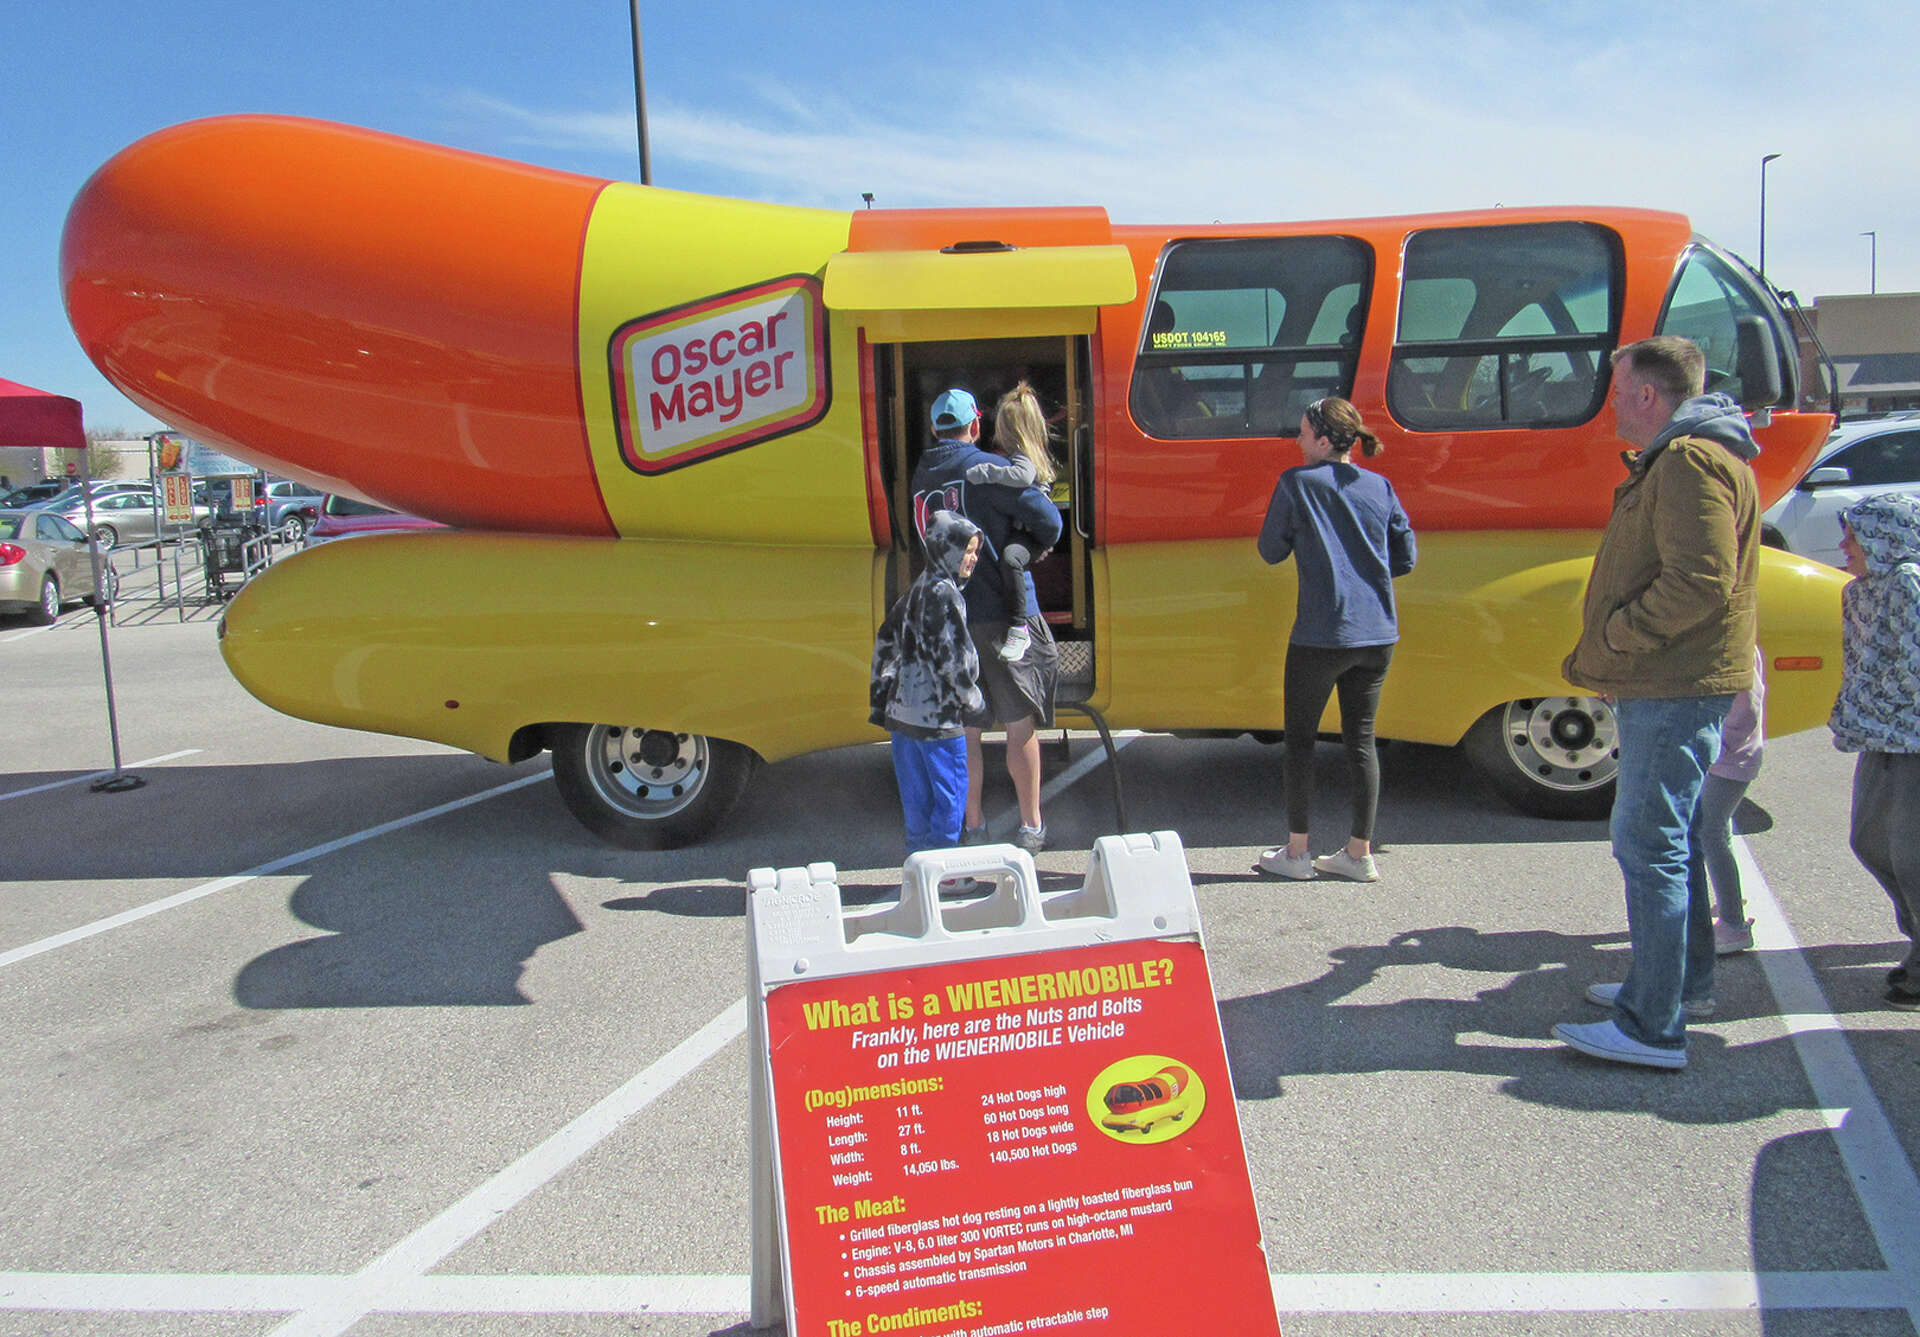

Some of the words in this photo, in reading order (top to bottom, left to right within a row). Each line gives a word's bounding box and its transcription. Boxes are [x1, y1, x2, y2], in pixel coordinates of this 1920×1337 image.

[651, 311, 788, 385] Oscar
[1152, 332, 1188, 344] USDOT
[1191, 331, 1227, 342] 104165
[649, 351, 794, 431] Mayer
[803, 996, 880, 1030] What
[888, 993, 914, 1020] is
[923, 994, 940, 1016] a
[946, 958, 1173, 1012] WIENERMOBILE?
[852, 1026, 918, 1048] Frankly,
[923, 1023, 959, 1040] here
[964, 1019, 991, 1034] are
[996, 1013, 1021, 1030] the
[1027, 1007, 1063, 1026] Nuts
[1068, 1001, 1097, 1021] and
[1102, 997, 1142, 1016] Bolts
[878, 1053, 898, 1068] on
[904, 1047, 930, 1064] the
[936, 1028, 1062, 1060] WIENERMOBILE
[1068, 1021, 1124, 1043] Vehicle
[805, 1077, 943, 1111] (Dog)mensions:
[981, 1094, 994, 1106] 24
[996, 1092, 1014, 1104] Hot
[1016, 1090, 1042, 1101] Dogs
[1044, 1084, 1066, 1098] high
[827, 1113, 863, 1127] Height:
[897, 1106, 907, 1118] 11
[911, 1105, 923, 1115] ft.
[984, 1113, 997, 1124] 60
[999, 1110, 1017, 1122] Hot
[1019, 1108, 1045, 1120] Dogs
[1047, 1105, 1069, 1116] long
[829, 1131, 868, 1146] Length:
[898, 1125, 911, 1136] 27
[914, 1123, 925, 1134] ft.
[987, 1131, 1000, 1143] 18
[1002, 1128, 1019, 1141] Hot
[1022, 1126, 1047, 1138] Dogs
[1049, 1121, 1074, 1133] wide
[830, 1151, 864, 1165] Width:
[901, 1144, 907, 1155] 8
[910, 1143, 921, 1154] ft.
[990, 1147, 1029, 1163] 140,500
[1032, 1145, 1049, 1157] Hot
[1052, 1142, 1077, 1154] Dogs
[833, 1171, 872, 1186] Weight:
[904, 1161, 938, 1176] 14,050
[940, 1159, 959, 1170] lbs.
[815, 1205, 849, 1224] The
[854, 1196, 906, 1219] Meat:
[850, 1225, 884, 1241] Grilled
[887, 1220, 940, 1236] fiberglass
[942, 1214, 960, 1227] hot
[962, 1212, 982, 1224] dog
[984, 1207, 1021, 1221] resting
[1023, 1205, 1036, 1215] on
[1039, 1203, 1045, 1212] a
[1048, 1197, 1079, 1212] lightly
[1082, 1189, 1119, 1206] toasted
[1122, 1184, 1171, 1199] fiberglass
[1173, 1181, 1193, 1191] bun
[852, 1245, 891, 1260] Engine:
[894, 1240, 916, 1253] V-8,
[918, 1237, 934, 1250] 6.0
[937, 1235, 958, 1246] liter
[961, 1230, 980, 1243] 300
[982, 1223, 1023, 1239] VORTEC
[1026, 1221, 1049, 1232] runs
[1052, 1218, 1064, 1228] on
[1067, 1209, 1127, 1227] high-octane
[1130, 1200, 1172, 1216] mustard
[854, 1262, 896, 1278] Chassis
[899, 1252, 956, 1272] assembled
[958, 1251, 971, 1264] by
[974, 1245, 1015, 1261] Spartan
[1017, 1239, 1054, 1252] Motors
[1056, 1235, 1066, 1246] in
[1069, 1228, 1118, 1244] Charlotte,
[1120, 1224, 1133, 1236] MI
[856, 1280, 900, 1297] 6-speed
[903, 1272, 956, 1290] automatic
[959, 1261, 1027, 1280] transmission
[827, 1320, 861, 1337] The
[867, 1301, 982, 1333] Condiments:
[970, 1320, 1024, 1337] automatic
[1026, 1310, 1083, 1329] retractable
[1086, 1307, 1108, 1319] step
